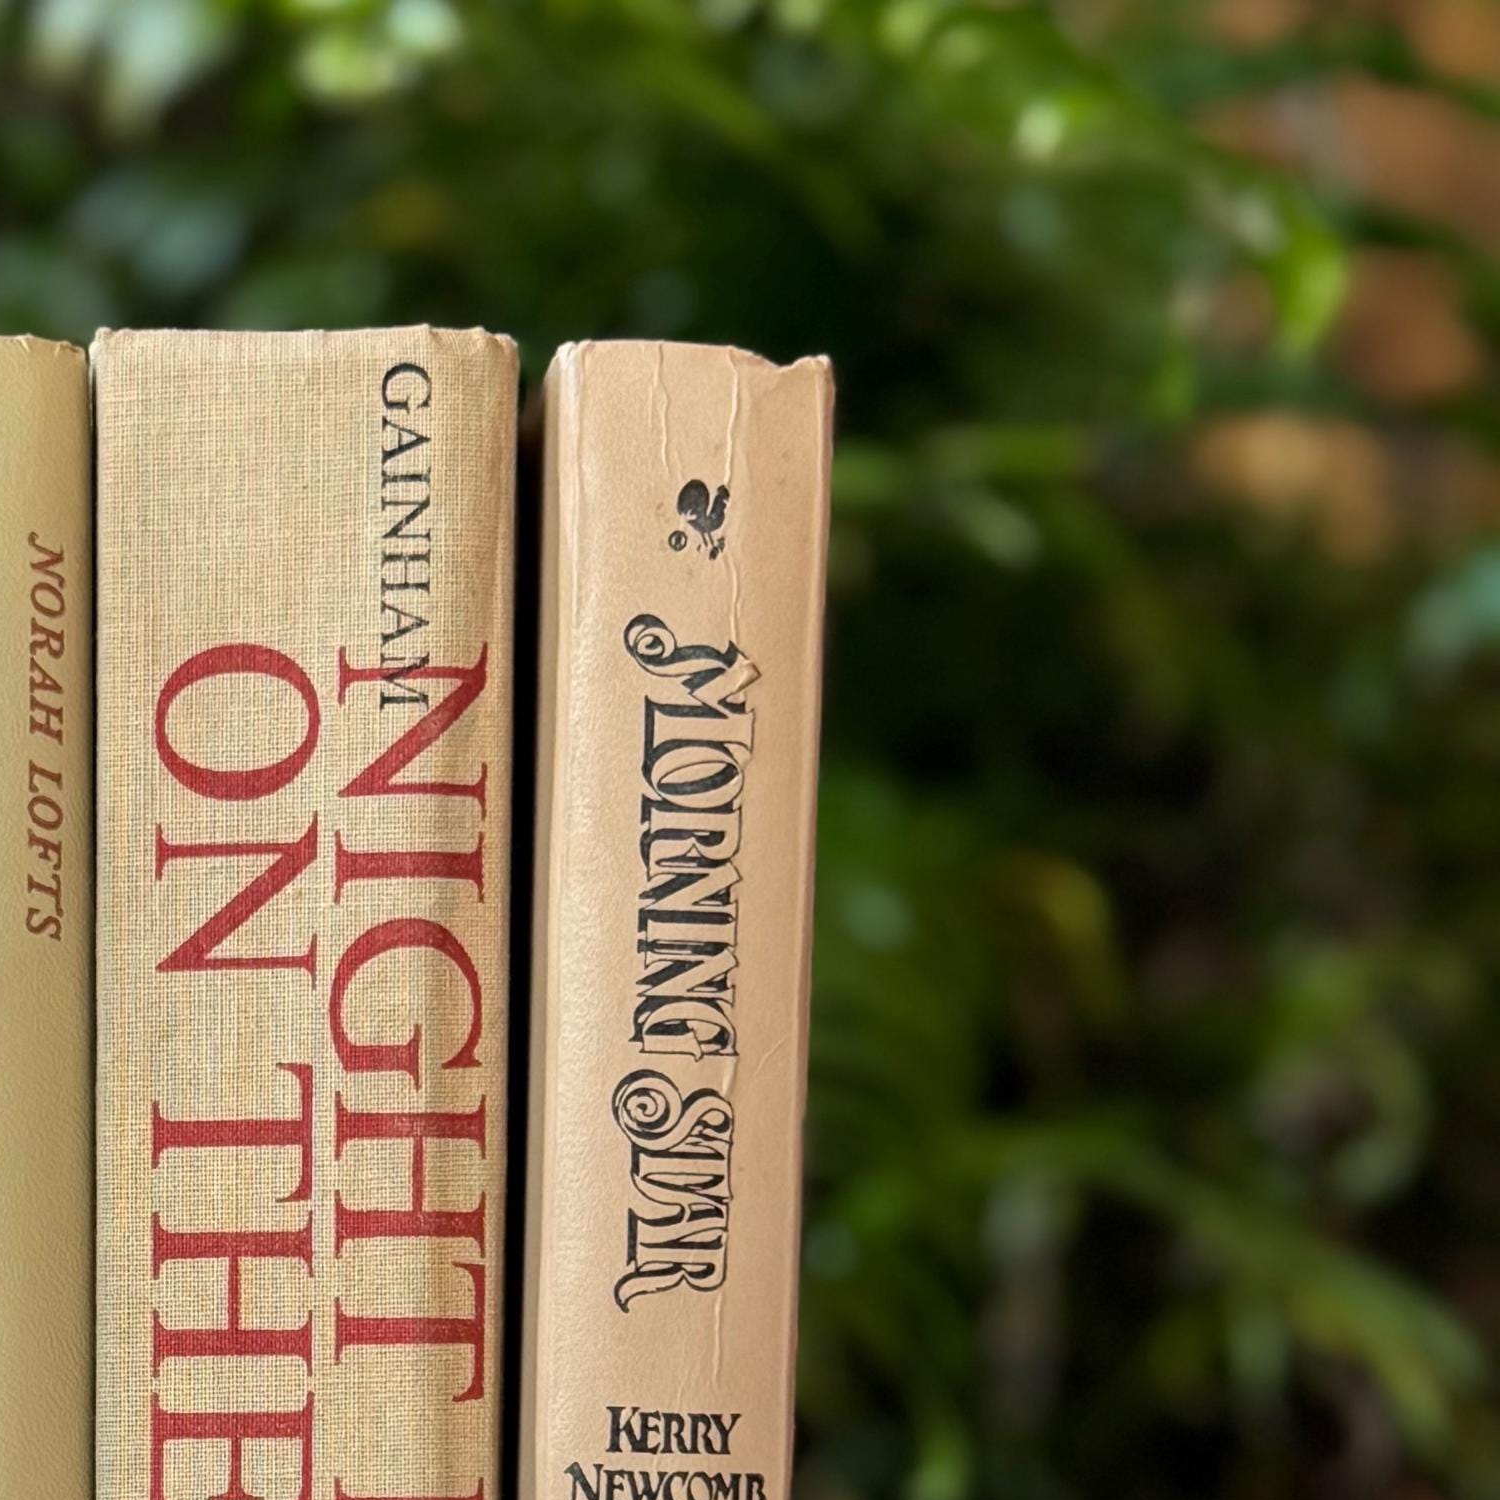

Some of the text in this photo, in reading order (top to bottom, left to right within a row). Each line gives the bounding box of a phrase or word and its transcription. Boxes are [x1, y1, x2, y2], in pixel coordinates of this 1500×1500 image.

[379, 361, 431, 717] GAINHAM
[25, 532, 68, 939] NORAH LOFTS
[153, 643, 318, 988] ON
[328, 642, 490, 1402] NIGHT
[612, 614, 762, 1313] MORNING STAR
[605, 1407, 741, 1455] KERRY
